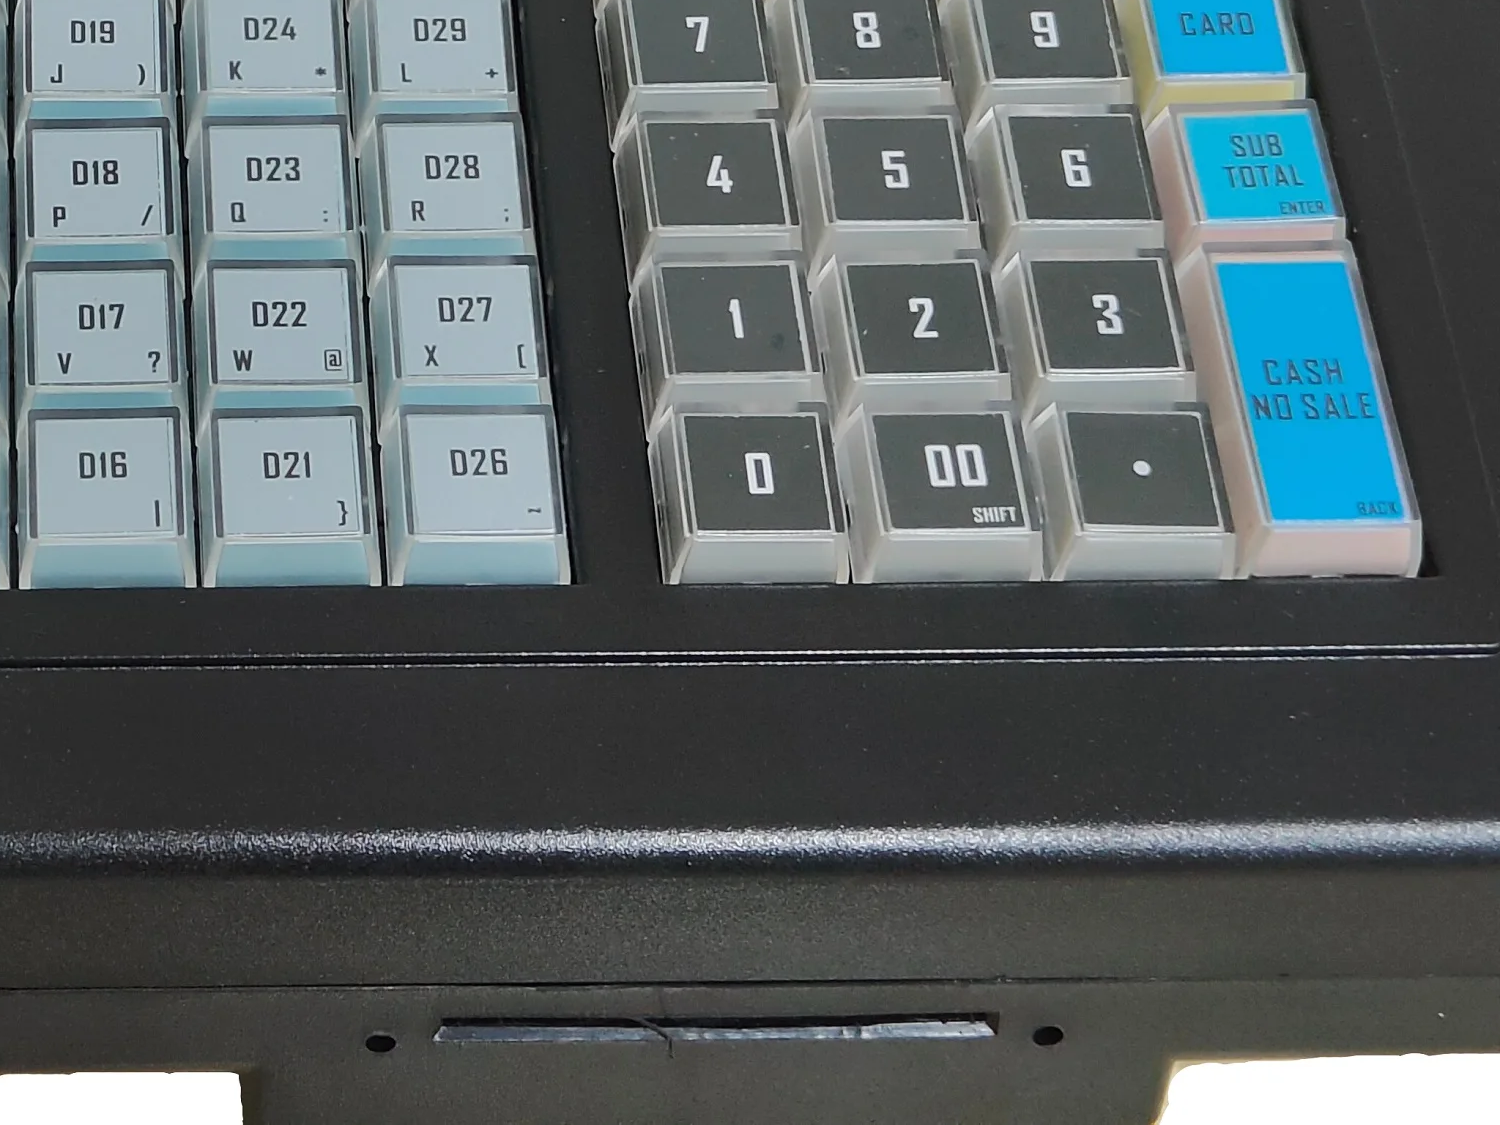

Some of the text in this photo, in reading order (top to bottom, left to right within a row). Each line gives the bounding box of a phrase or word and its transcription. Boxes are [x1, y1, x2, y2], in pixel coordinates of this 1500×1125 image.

[71, 21, 114, 43] D19
[244, 18, 296, 40] D24
[414, 19, 466, 41] D29
[686, 17, 709, 52] 7
[853, 12, 881, 48] 8
[1031, 12, 1059, 47] 9
[1181, 13, 1254, 35] CARD
[51, 64, 62, 83] J
[230, 61, 242, 80] K
[401, 63, 412, 82] L
[1231, 135, 1282, 156] SUB
[73, 160, 118, 185] D18
[247, 157, 300, 181] D23
[425, 155, 479, 179] D28
[707, 156, 733, 193] 4
[882, 151, 909, 188] 5
[1061, 150, 1091, 186] 6
[1223, 165, 1304, 187] TOTAL
[53, 207, 65, 227] P
[231, 202, 246, 222] Q
[412, 201, 425, 221] R
[1279, 201, 1324, 214] ENTER
[79, 304, 124, 329] D17
[252, 302, 307, 326] D22
[438, 297, 491, 322] D27
[729, 299, 744, 338] 1
[909, 298, 938, 338] 2
[1092, 295, 1123, 334] 3
[58, 353, 71, 374] V
[233, 350, 252, 371] W
[425, 345, 438, 366] X
[1262, 359, 1342, 385] CASH
[1300, 393, 1375, 419] SALE
[80, 452, 127, 478] D16
[264, 452, 310, 478] D21
[450, 449, 507, 476] D26
[973, 507, 1015, 523] SHIFT
